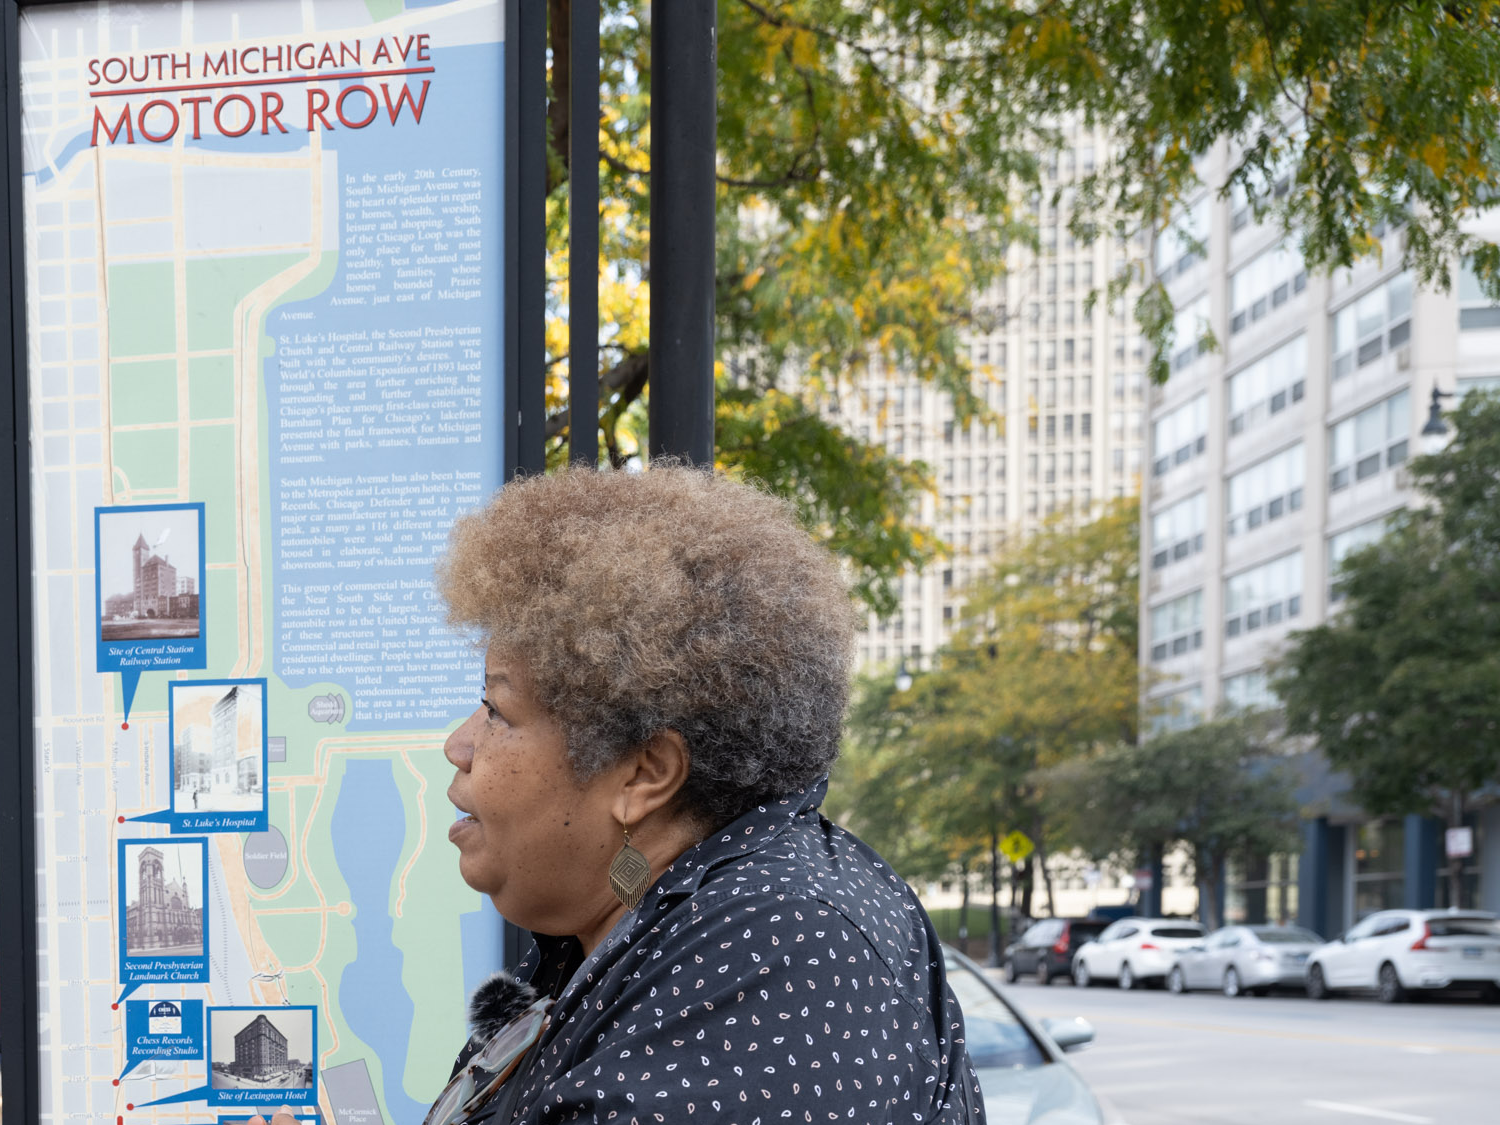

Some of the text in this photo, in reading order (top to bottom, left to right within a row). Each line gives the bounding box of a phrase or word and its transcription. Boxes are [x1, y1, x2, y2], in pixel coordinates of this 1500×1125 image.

[88, 33, 431, 86] SOUTH MICHIGAN AVE
[90, 80, 430, 147] MOTOR ROW
[108, 644, 193, 656] Site of Central Station
[120, 655, 180, 668] Railway Station
[194, 818, 220, 827] Luke's
[222, 817, 255, 829] Hospital
[125, 960, 203, 972] Second Presbyterian
[129, 971, 198, 980] Landmark Church
[136, 1035, 193, 1045] Chess Records
[132, 1046, 198, 1056] Recording Studio
[218, 1091, 306, 1102] Site of Lexington Hotel
